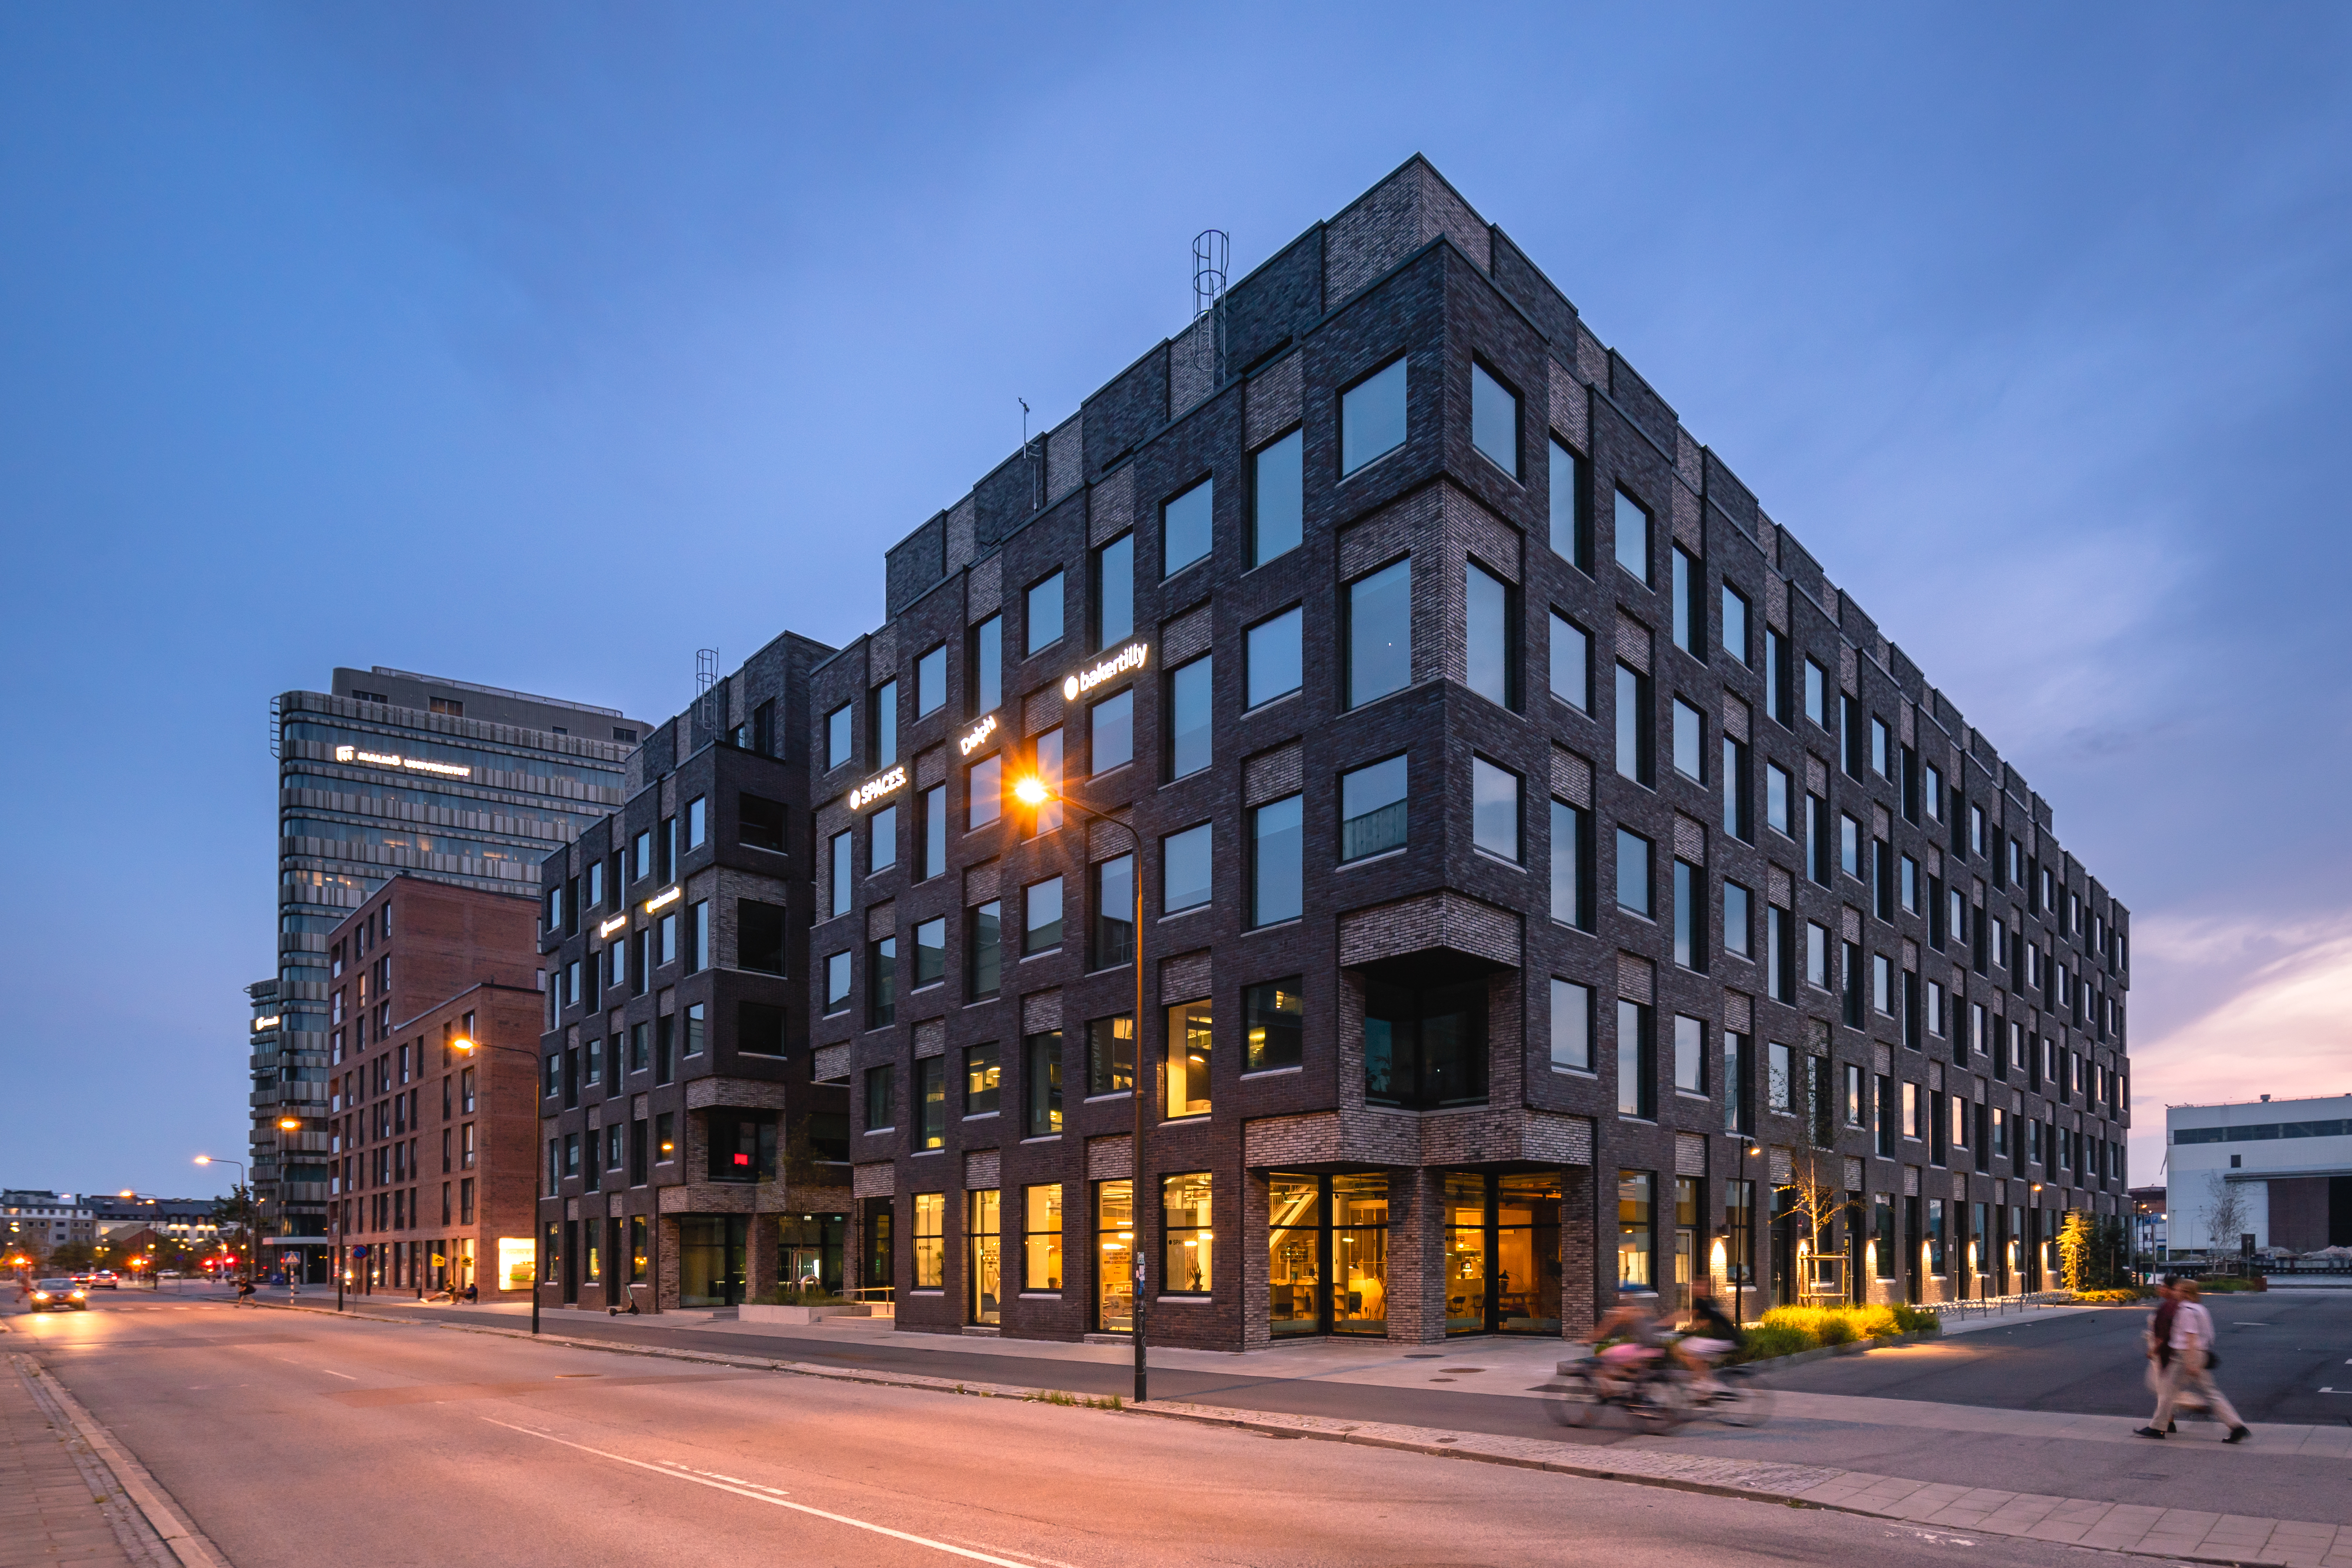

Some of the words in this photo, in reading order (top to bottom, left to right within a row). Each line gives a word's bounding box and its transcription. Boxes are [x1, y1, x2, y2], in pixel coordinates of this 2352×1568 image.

[1080, 643, 1148, 692] bakertilly
[960, 715, 997, 757] Delphi
[357, 752, 401, 766] MALMÖ
[404, 759, 470, 777] UNIVERSITET
